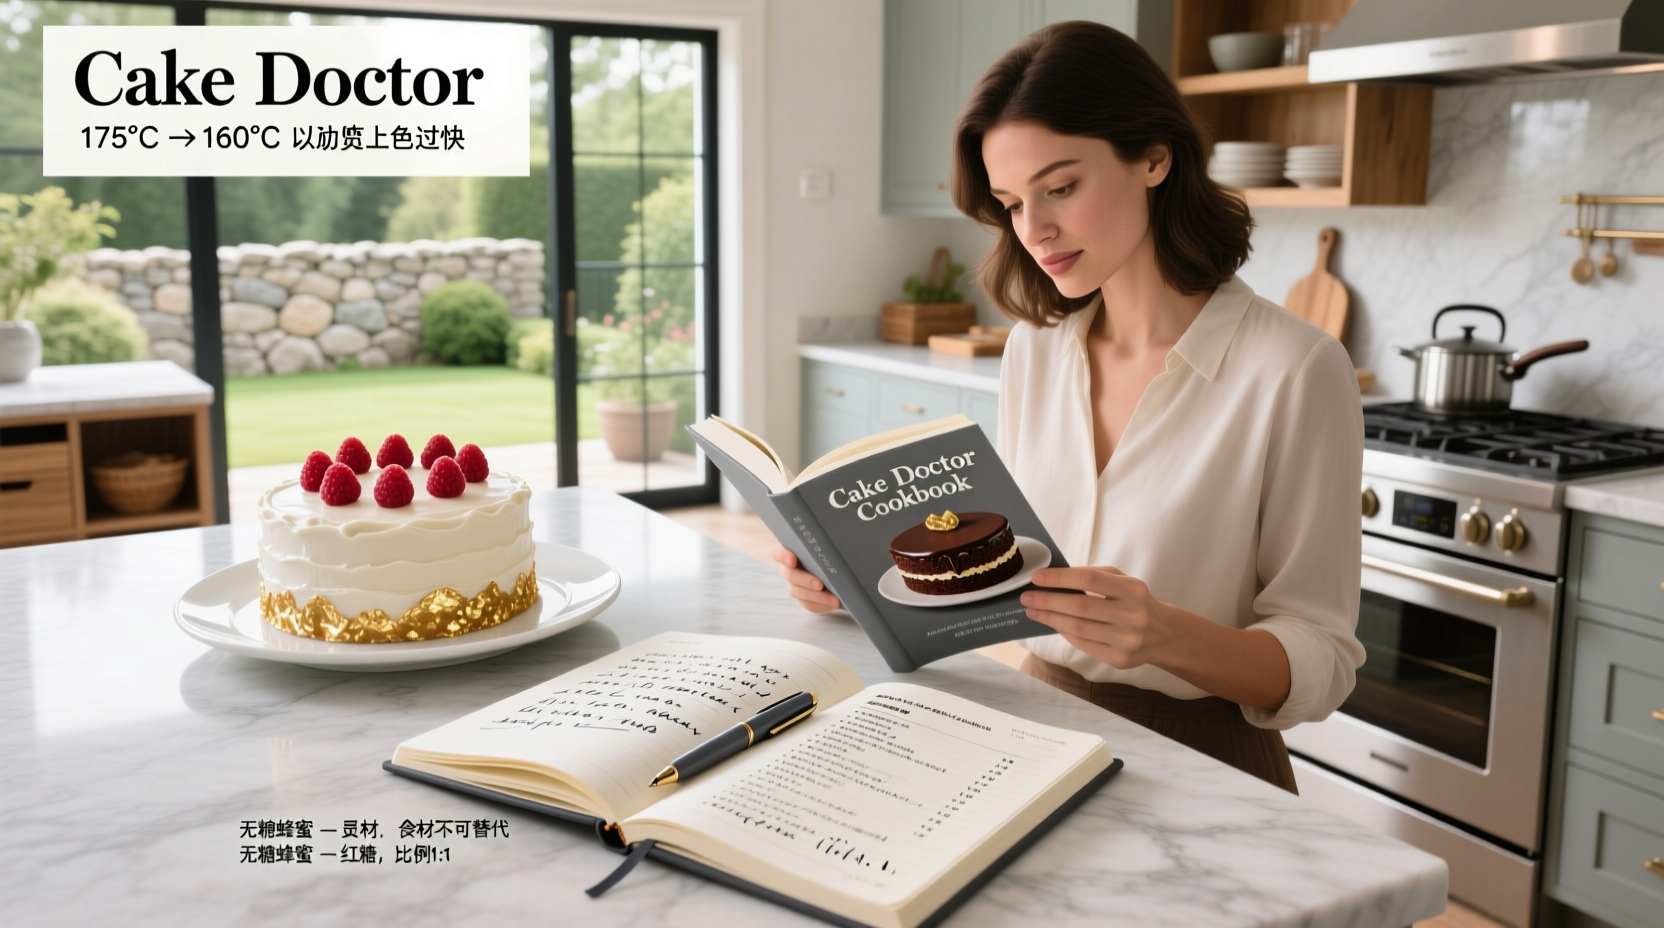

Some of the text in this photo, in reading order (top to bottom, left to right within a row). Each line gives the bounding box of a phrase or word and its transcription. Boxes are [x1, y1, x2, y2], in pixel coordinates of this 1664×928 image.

[828, 450, 976, 510] Cake Doctor
[856, 473, 974, 522] Cookbook
